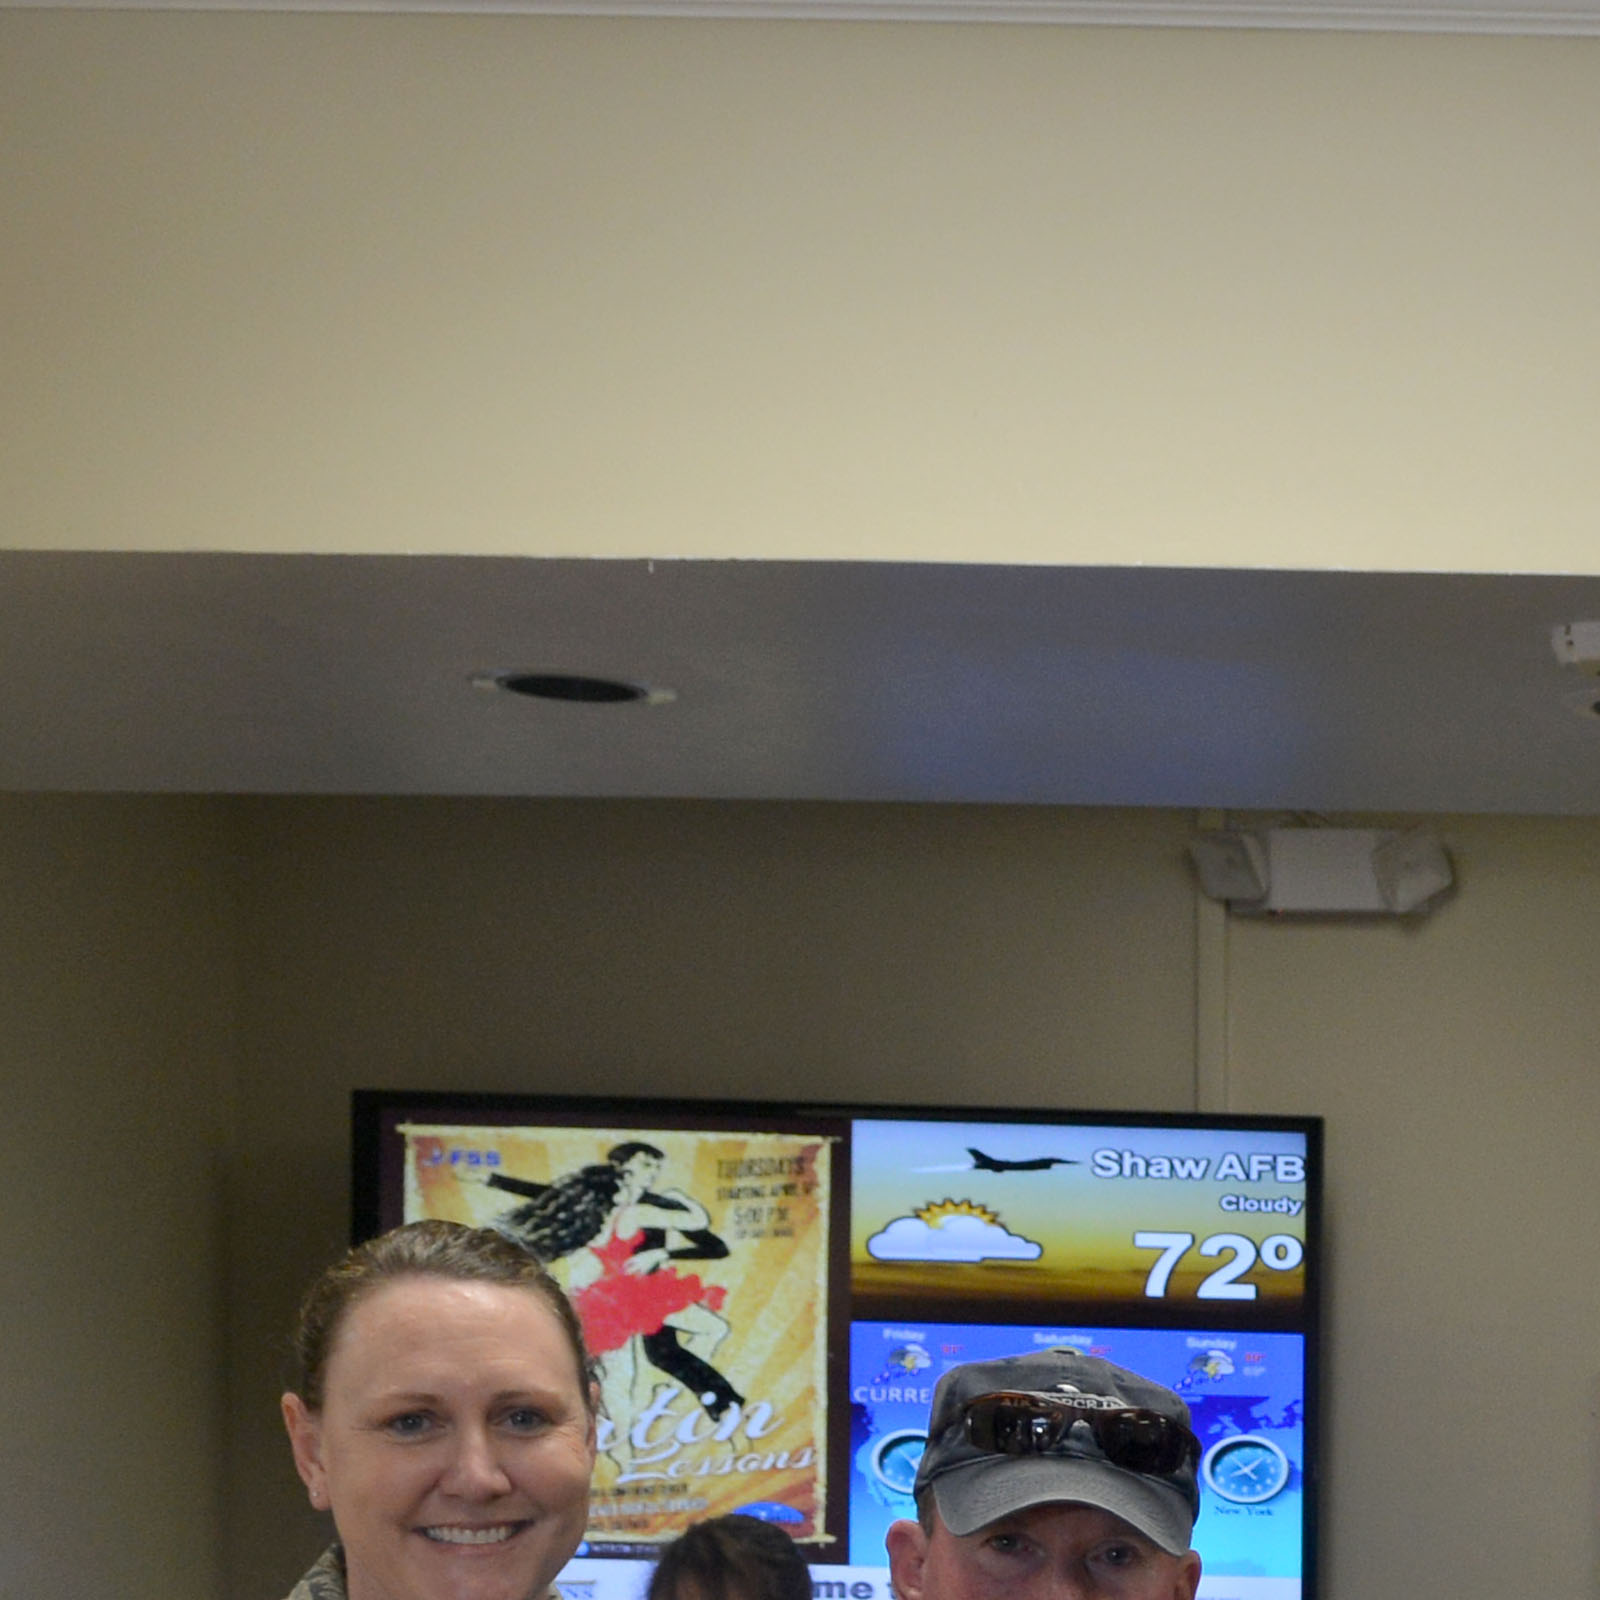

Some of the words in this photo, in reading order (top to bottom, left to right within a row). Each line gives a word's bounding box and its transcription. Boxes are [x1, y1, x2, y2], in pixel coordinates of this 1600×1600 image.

[1092, 1149, 1208, 1179] Shaw
[1215, 1153, 1306, 1183] AFB
[1219, 1195, 1301, 1217] Cloudy
[882, 1328, 926, 1343] Friday
[1033, 1331, 1092, 1346] Saturday
[1186, 1336, 1237, 1351] Sunday
[617, 1440, 816, 1483] Lessons
[1215, 1505, 1242, 1516] New
[1246, 1505, 1274, 1517] York
